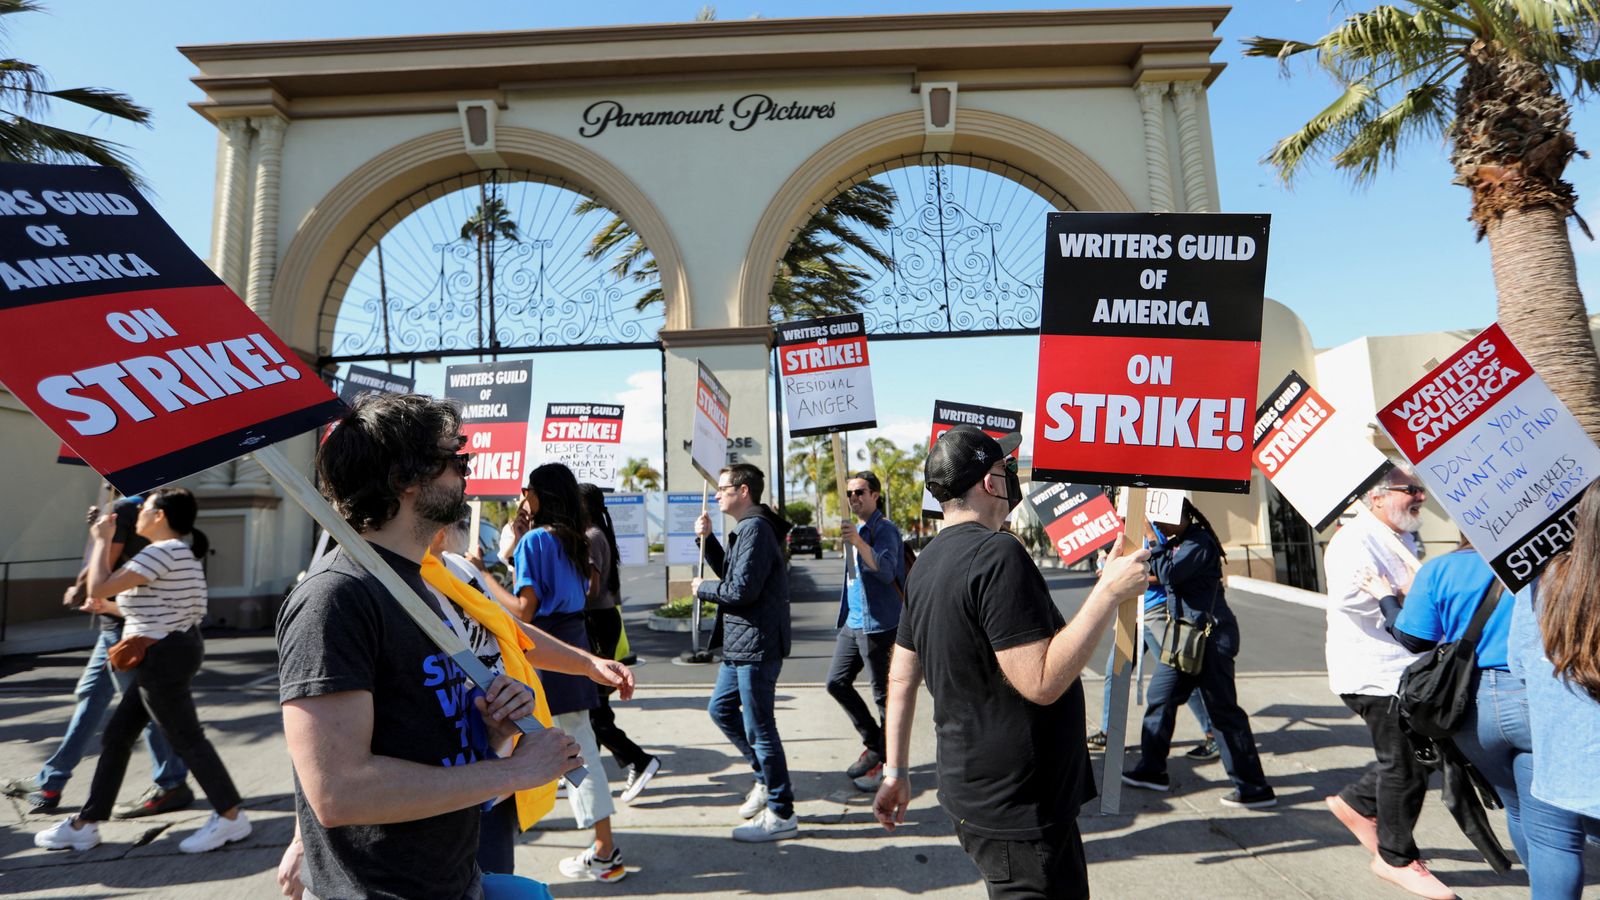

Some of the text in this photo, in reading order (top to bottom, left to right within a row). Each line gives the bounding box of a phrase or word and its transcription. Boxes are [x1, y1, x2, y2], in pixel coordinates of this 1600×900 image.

[579, 94, 836, 138] Paramount Pictures
[41, 190, 139, 216] GUILD
[25, 225, 70, 247] OF
[1058, 233, 1256, 261] WRITERS GUILD
[0, 253, 160, 291] AMERICA
[1139, 269, 1167, 290] OF
[106, 308, 178, 344] ON
[1092, 298, 1210, 326] AMERICA
[783, 322, 860, 341] WRITERS GUILD
[817, 338, 828, 346] ON
[785, 342, 864, 372] STRIKE!
[1126, 354, 1173, 385] ON
[36, 333, 302, 436] STRIKE!
[349, 372, 409, 394] WRITERS GUILD
[450, 370, 528, 388] WRITERS GUILD
[786, 376, 855, 396] RESIDUAL
[1391, 338, 1496, 420] WRITERS
[480, 389, 492, 401] OF
[798, 394, 859, 420] ANGER
[1274, 381, 1302, 411] GUILD
[1407, 357, 1503, 432] GUILD OF
[461, 403, 508, 419] AMERICA
[551, 405, 621, 416] WRITERS GUILD
[939, 408, 1016, 430] WRITERS GUILD
[1043, 391, 1246, 452] STRIKE!
[1415, 366, 1521, 453] AMERICA
[472, 432, 492, 448] ON
[546, 421, 618, 440] STRIKE!
[1258, 396, 1328, 473] STRIKE!
[545, 443, 605, 454] RESPECT
[1430, 405, 1529, 485] DON'T YOU
[1446, 407, 1559, 504] WANT TO FIND
[571, 467, 616, 482] TERS!
[1059, 490, 1069, 500] OF
[1462, 462, 1529, 526] OUT HOW
[1479, 453, 1577, 542] YELLOWJACKETS
[1545, 466, 1589, 512] ENDS?
[1053, 491, 1088, 517] AMERICA
[1057, 510, 1120, 556] STRIKE!
[1071, 511, 1089, 527] ON
[1505, 502, 1580, 581] STRI
